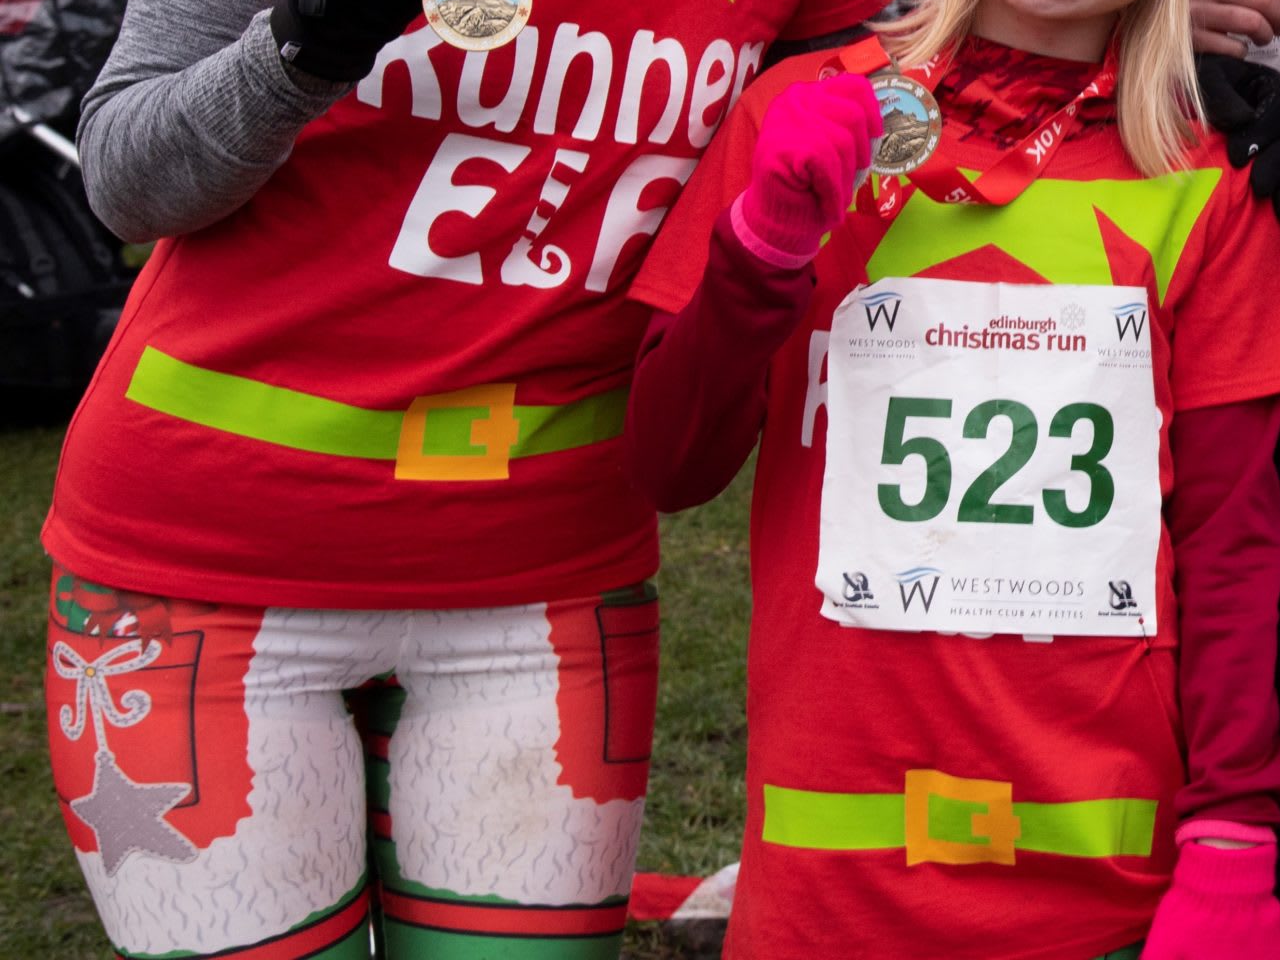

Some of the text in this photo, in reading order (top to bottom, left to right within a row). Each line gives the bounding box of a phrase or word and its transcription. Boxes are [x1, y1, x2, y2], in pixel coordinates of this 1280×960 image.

[357, 22, 766, 149] Runner
[1025, 120, 1062, 165] 10K
[388, 132, 700, 294] ELF
[924, 323, 1087, 352] christmas run
[988, 315, 1056, 333] edinburgh
[848, 338, 917, 350] WESTWOODS
[876, 395, 1116, 529] 523
[950, 576, 1085, 597] WESTWOODS
[949, 607, 1084, 620] HEALTH CLUB AT FETTES
